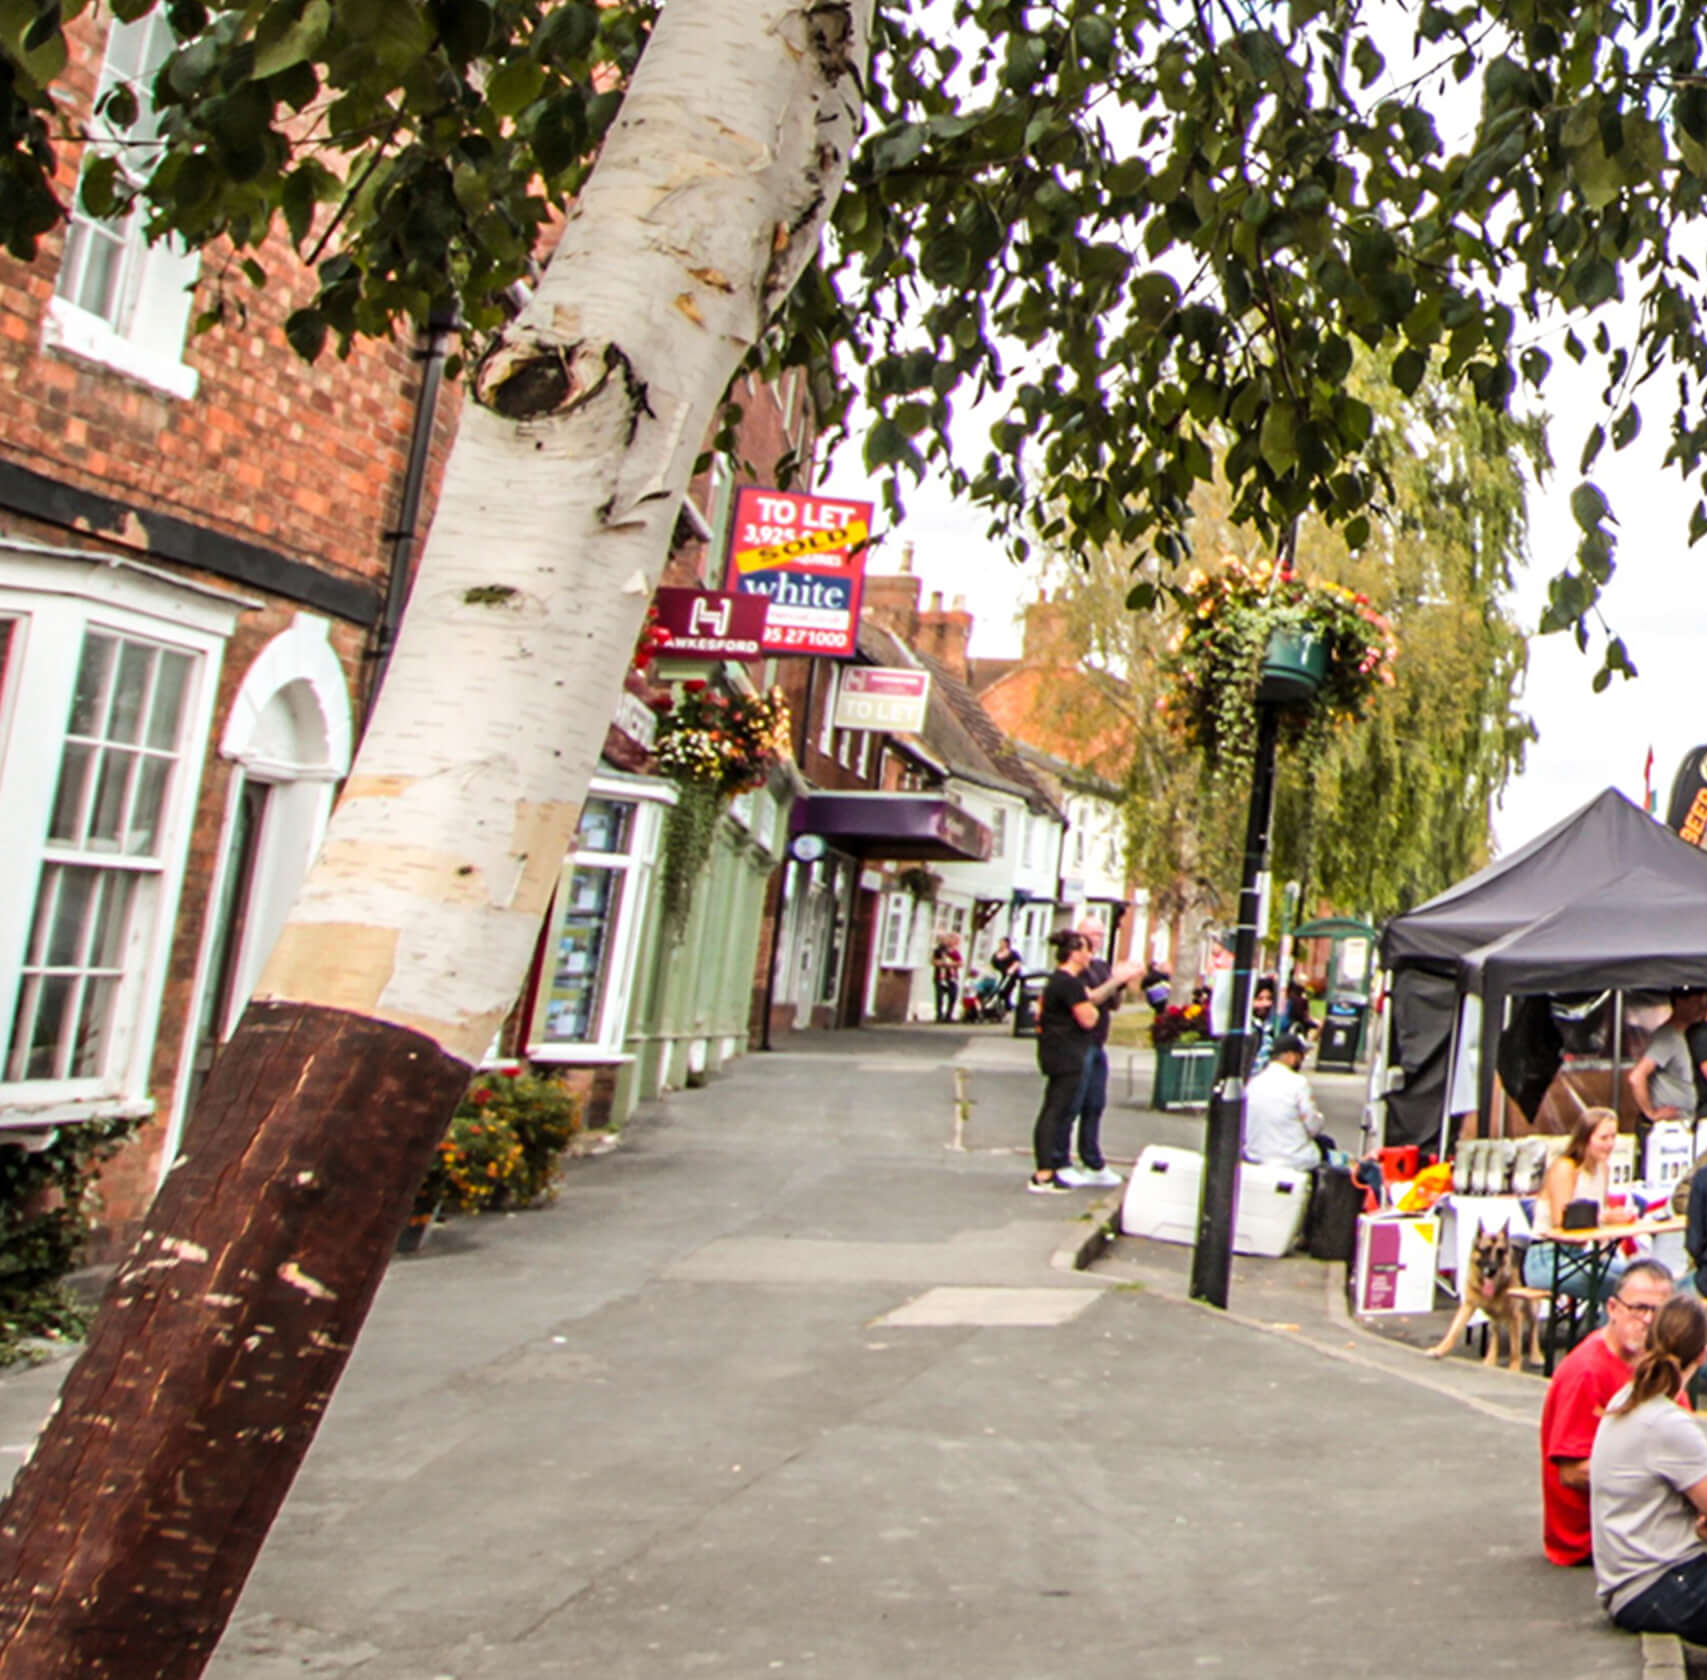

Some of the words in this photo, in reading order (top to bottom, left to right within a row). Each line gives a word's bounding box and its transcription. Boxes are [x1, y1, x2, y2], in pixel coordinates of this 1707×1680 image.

[757, 496, 797, 525] TO
[802, 502, 857, 529] LET
[758, 528, 848, 558] SOLD
[744, 571, 845, 609] white
[653, 637, 760, 654] AWKESFORD
[784, 628, 848, 648] 271000
[844, 699, 872, 719] TO
